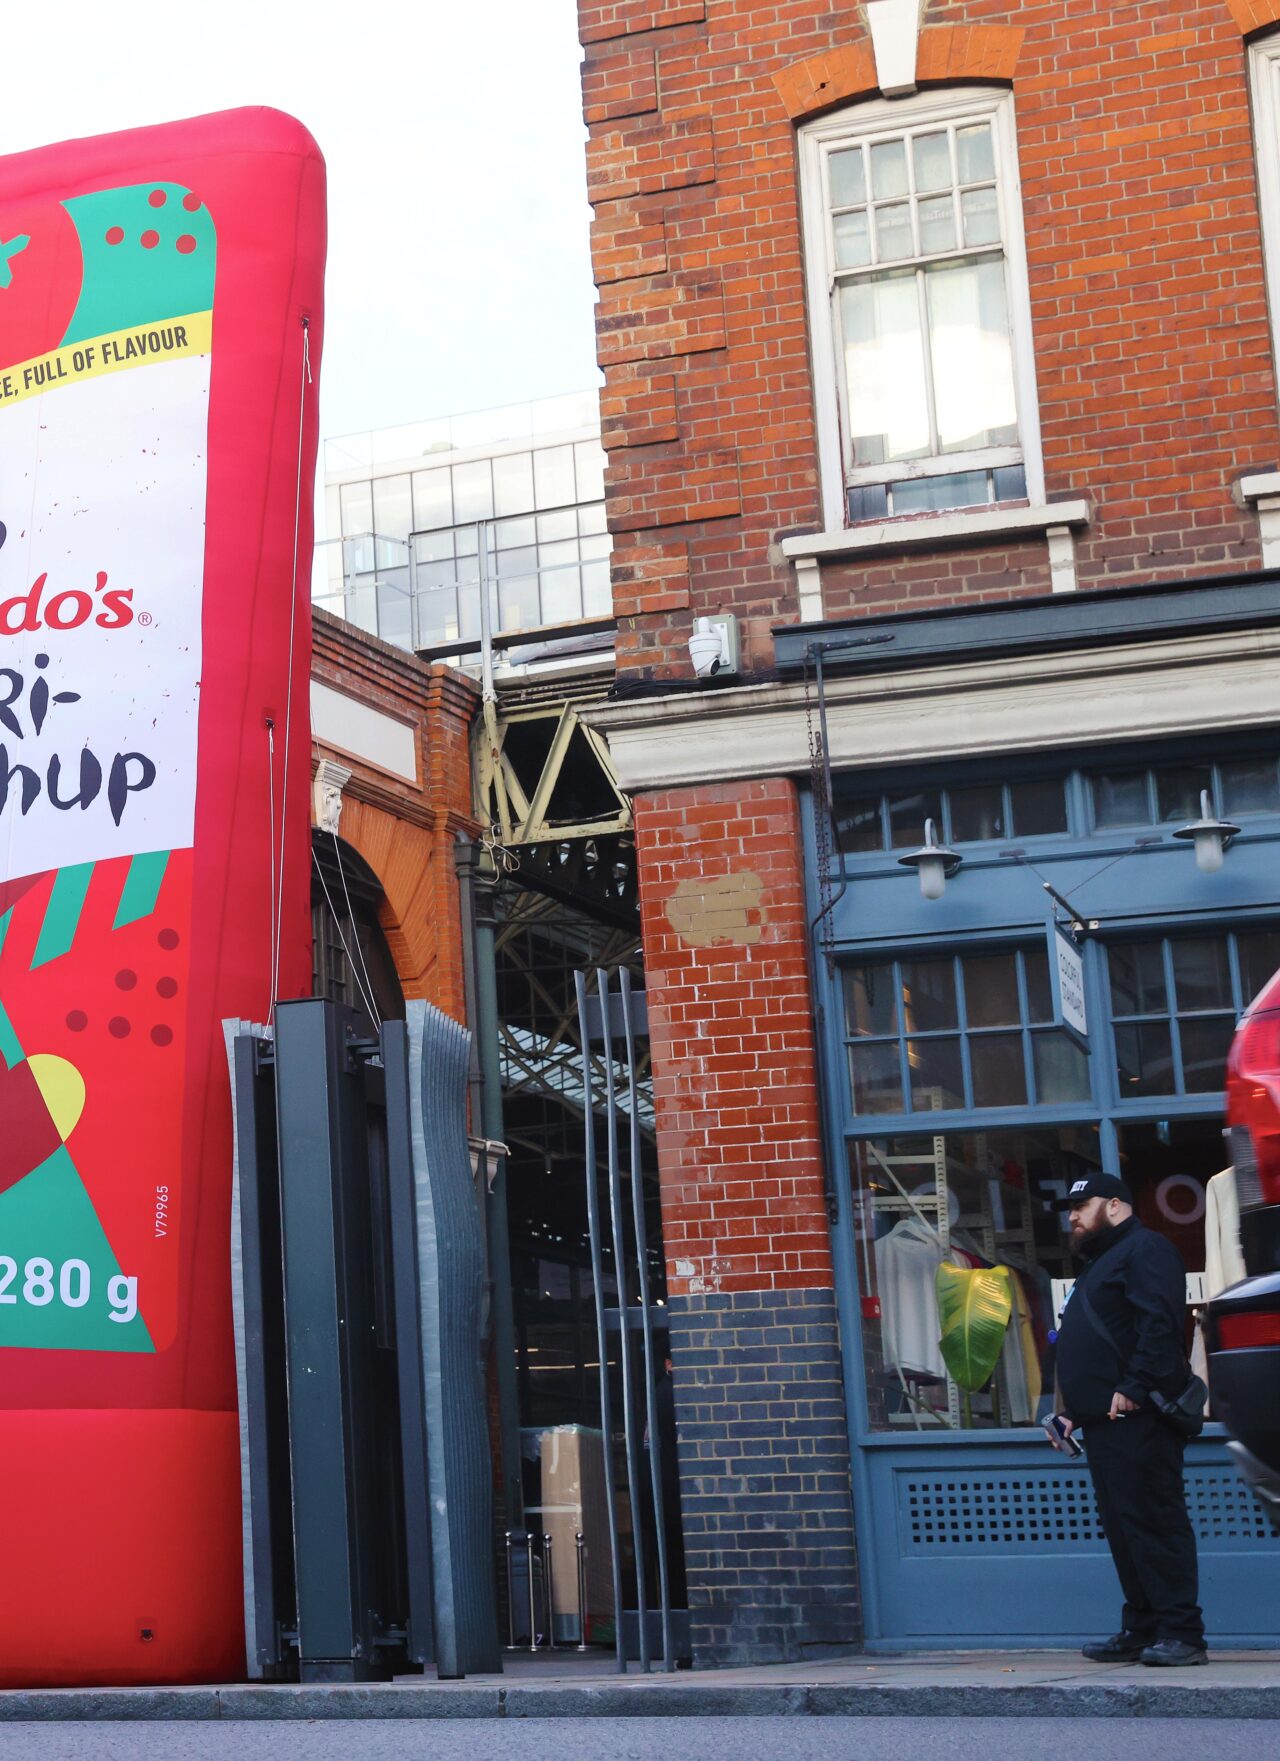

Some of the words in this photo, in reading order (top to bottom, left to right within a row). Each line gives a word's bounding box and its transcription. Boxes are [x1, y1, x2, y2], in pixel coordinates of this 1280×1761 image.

[23, 356, 67, 391] FULL
[72, 347, 96, 373] OF
[101, 325, 189, 365] FLAVOUR
[155, 1185, 168, 1238] V79965
[107, 1272, 139, 1323] g
